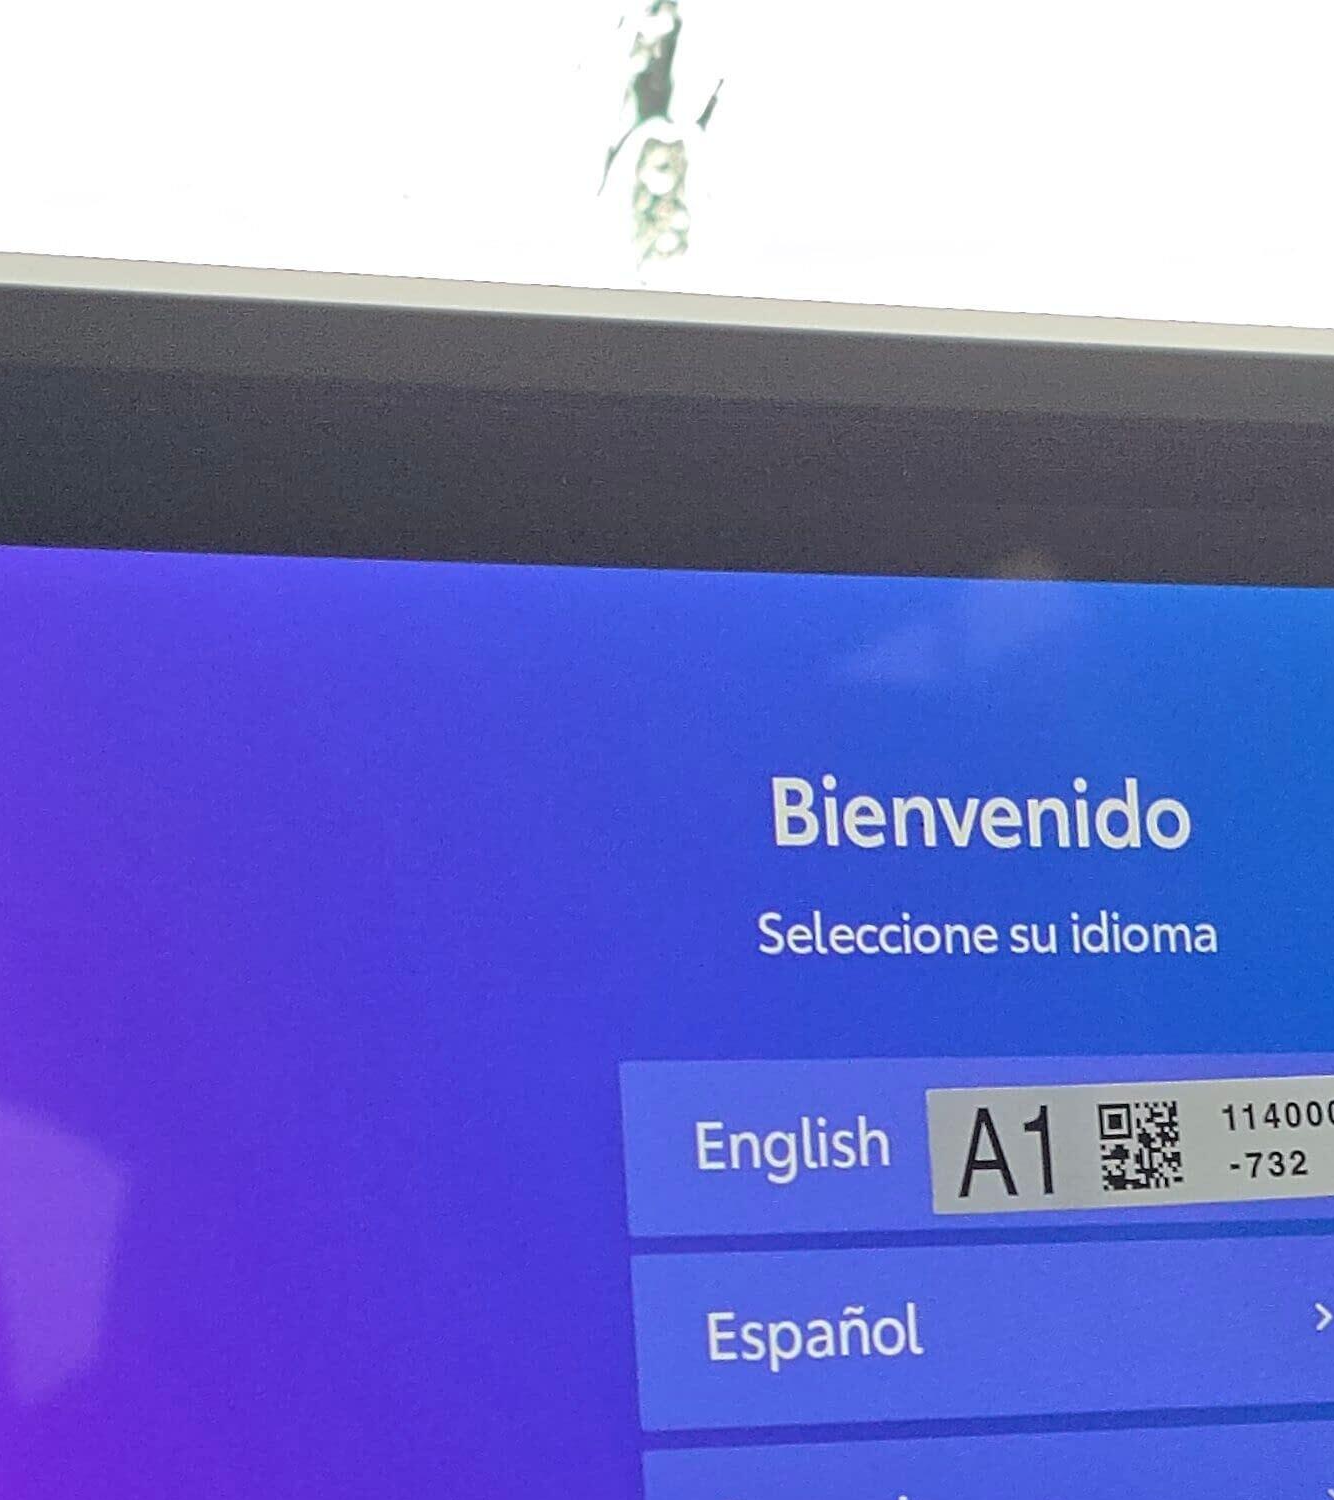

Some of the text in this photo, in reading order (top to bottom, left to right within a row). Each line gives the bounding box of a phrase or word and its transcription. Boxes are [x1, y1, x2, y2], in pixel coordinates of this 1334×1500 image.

[771, 774, 1192, 851] Bienvenido
[757, 910, 1218, 955] Seleccione su idioma
[695, 1115, 891, 1185] English
[958, 1104, 1055, 1198] A1
[1230, 1150, 1310, 1180] -732
[705, 1303, 924, 1372] Español
